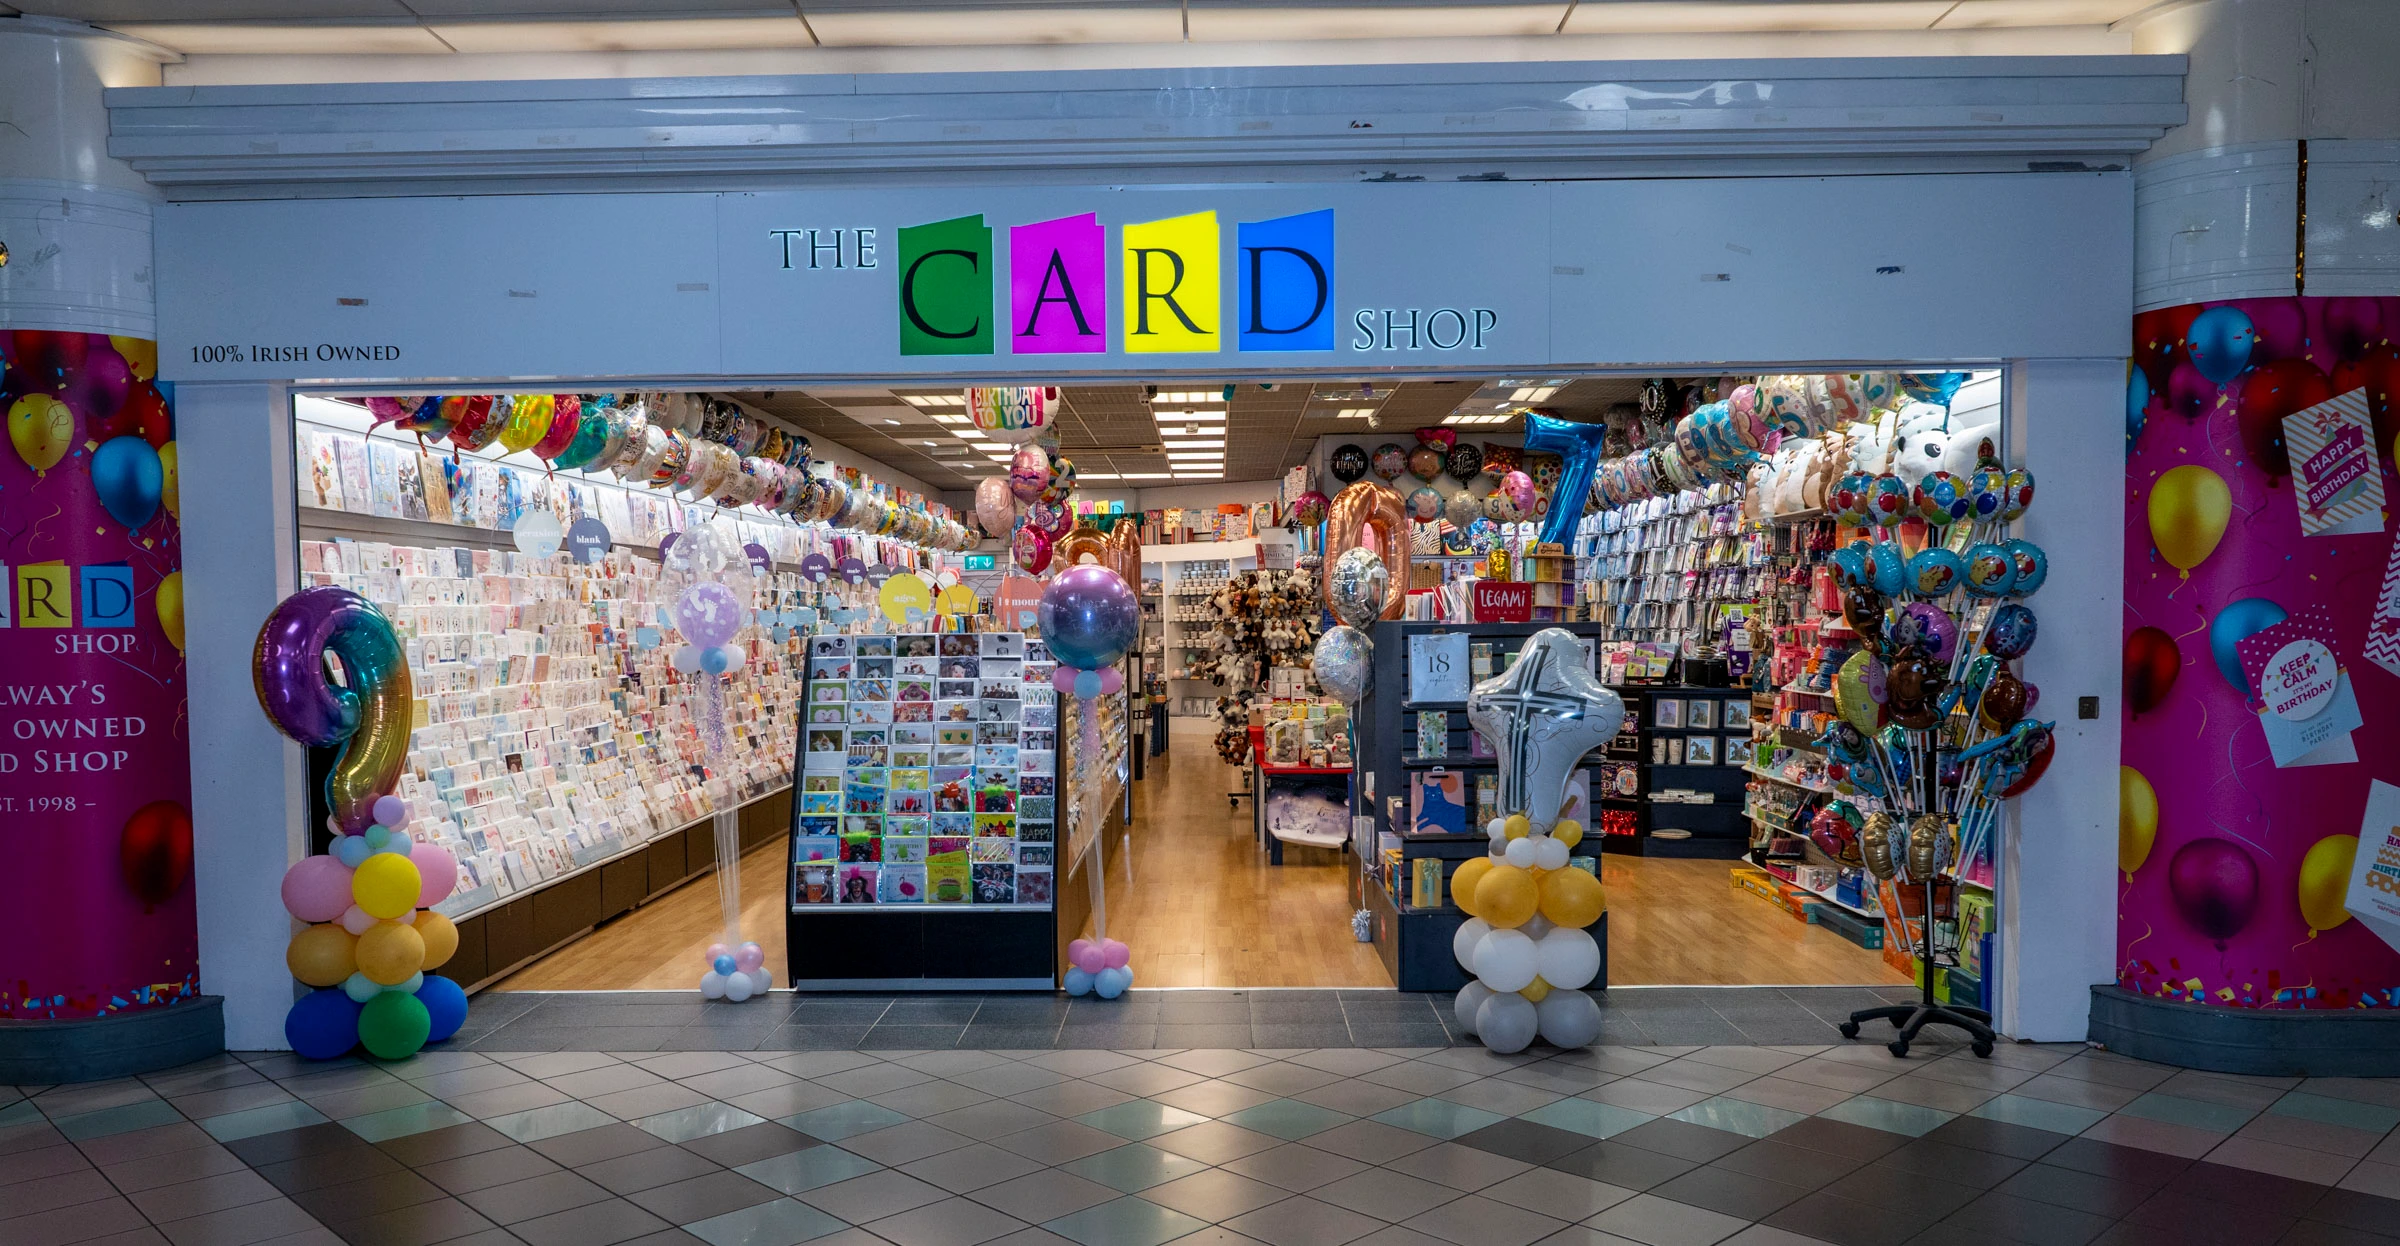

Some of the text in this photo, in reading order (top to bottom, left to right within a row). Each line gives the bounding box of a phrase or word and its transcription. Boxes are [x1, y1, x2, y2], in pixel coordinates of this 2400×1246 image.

[769, 228, 1497, 351] THE CARD SHOP
[191, 343, 400, 363] 100% IRISH OWNED
[976, 405, 1038, 427] TO YOU
[2310, 436, 2353, 474] HAPPY
[2311, 457, 2366, 504] BIRTHDAY
[576, 535, 601, 544] blank
[55, 634, 136, 654] SHOP
[1428, 652, 1450, 673] 18
[2279, 652, 2311, 676] KEEP
[2282, 665, 2317, 689] CALM
[2276, 679, 2333, 714] BIRTHDAY
[13, 716, 146, 739] OWNED
[34, 750, 129, 773] SHOP
[28, 797, 77, 812] 1998
[1020, 829, 1052, 840] HAPPY
